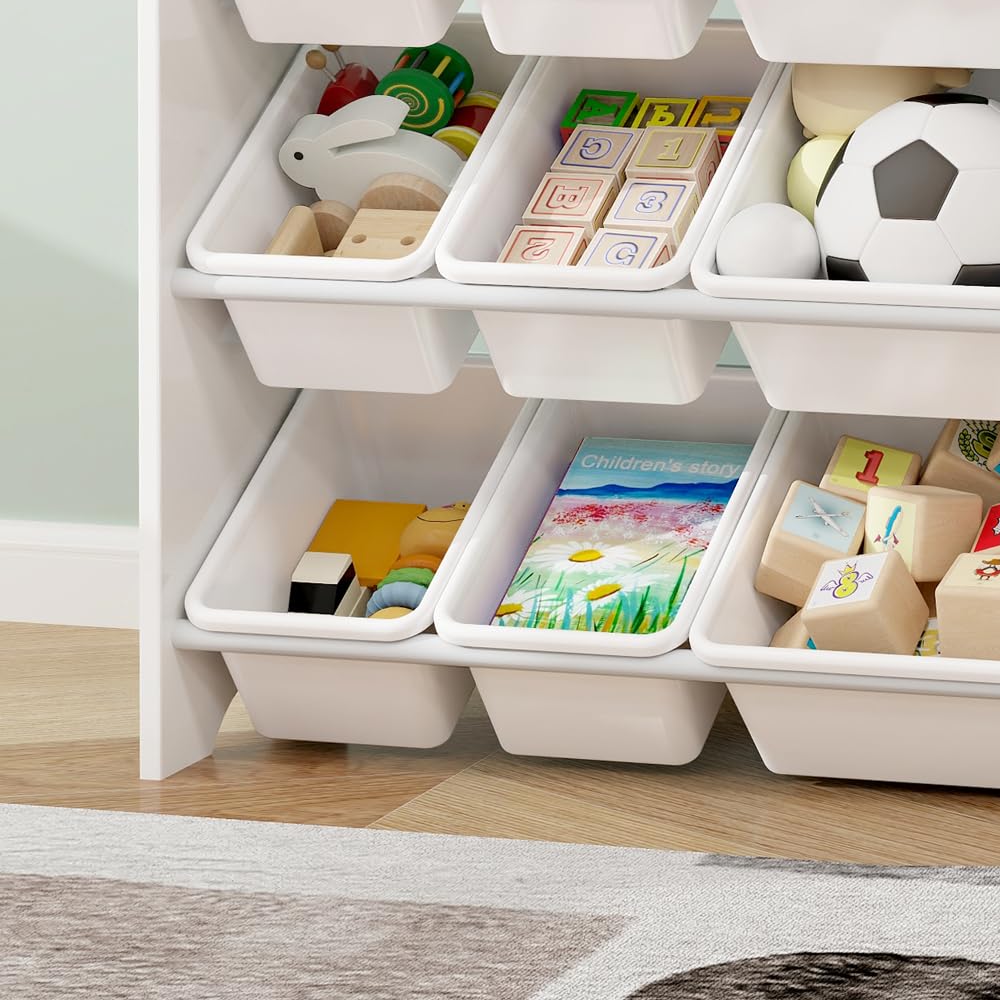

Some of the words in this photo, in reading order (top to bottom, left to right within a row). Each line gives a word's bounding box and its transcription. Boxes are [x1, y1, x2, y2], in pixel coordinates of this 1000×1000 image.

[656, 136, 684, 161] 1
[545, 184, 590, 210] B
[634, 190, 668, 214] 3
[580, 454, 681, 473] Children's
[687, 460, 742, 478] story
[856, 449, 884, 486] 1
[832, 571, 860, 599] 8
